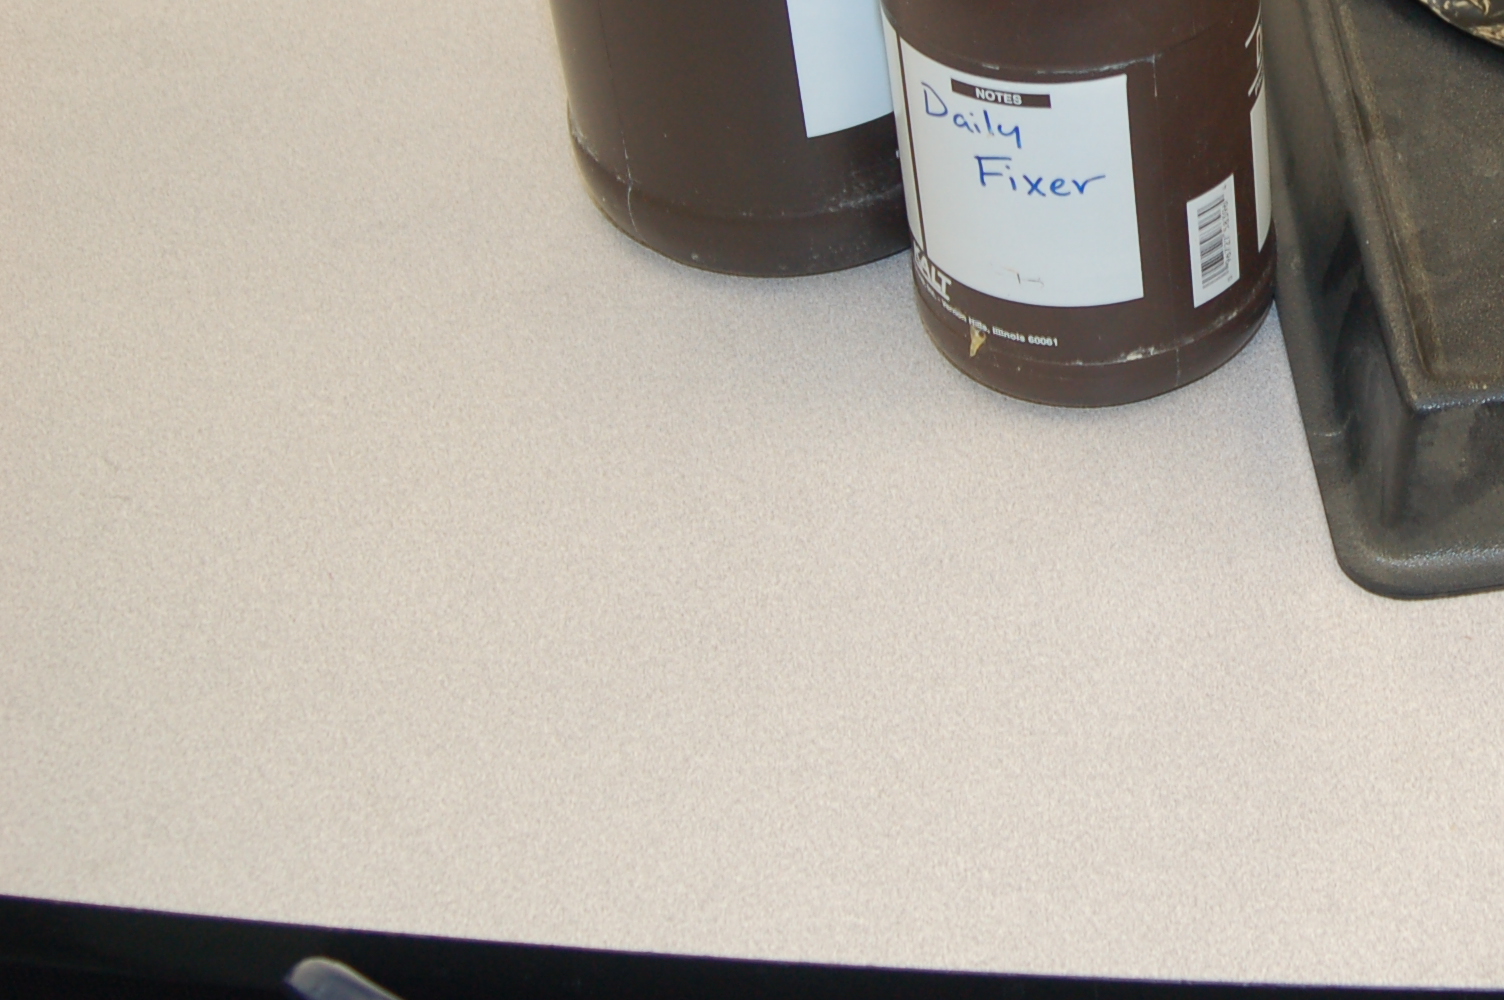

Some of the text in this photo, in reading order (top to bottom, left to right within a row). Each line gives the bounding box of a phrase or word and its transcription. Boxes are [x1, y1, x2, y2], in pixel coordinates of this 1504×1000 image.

[921, 81, 1022, 149] Daily
[975, 87, 1023, 106] NOTES
[974, 155, 1106, 197] Fixer
